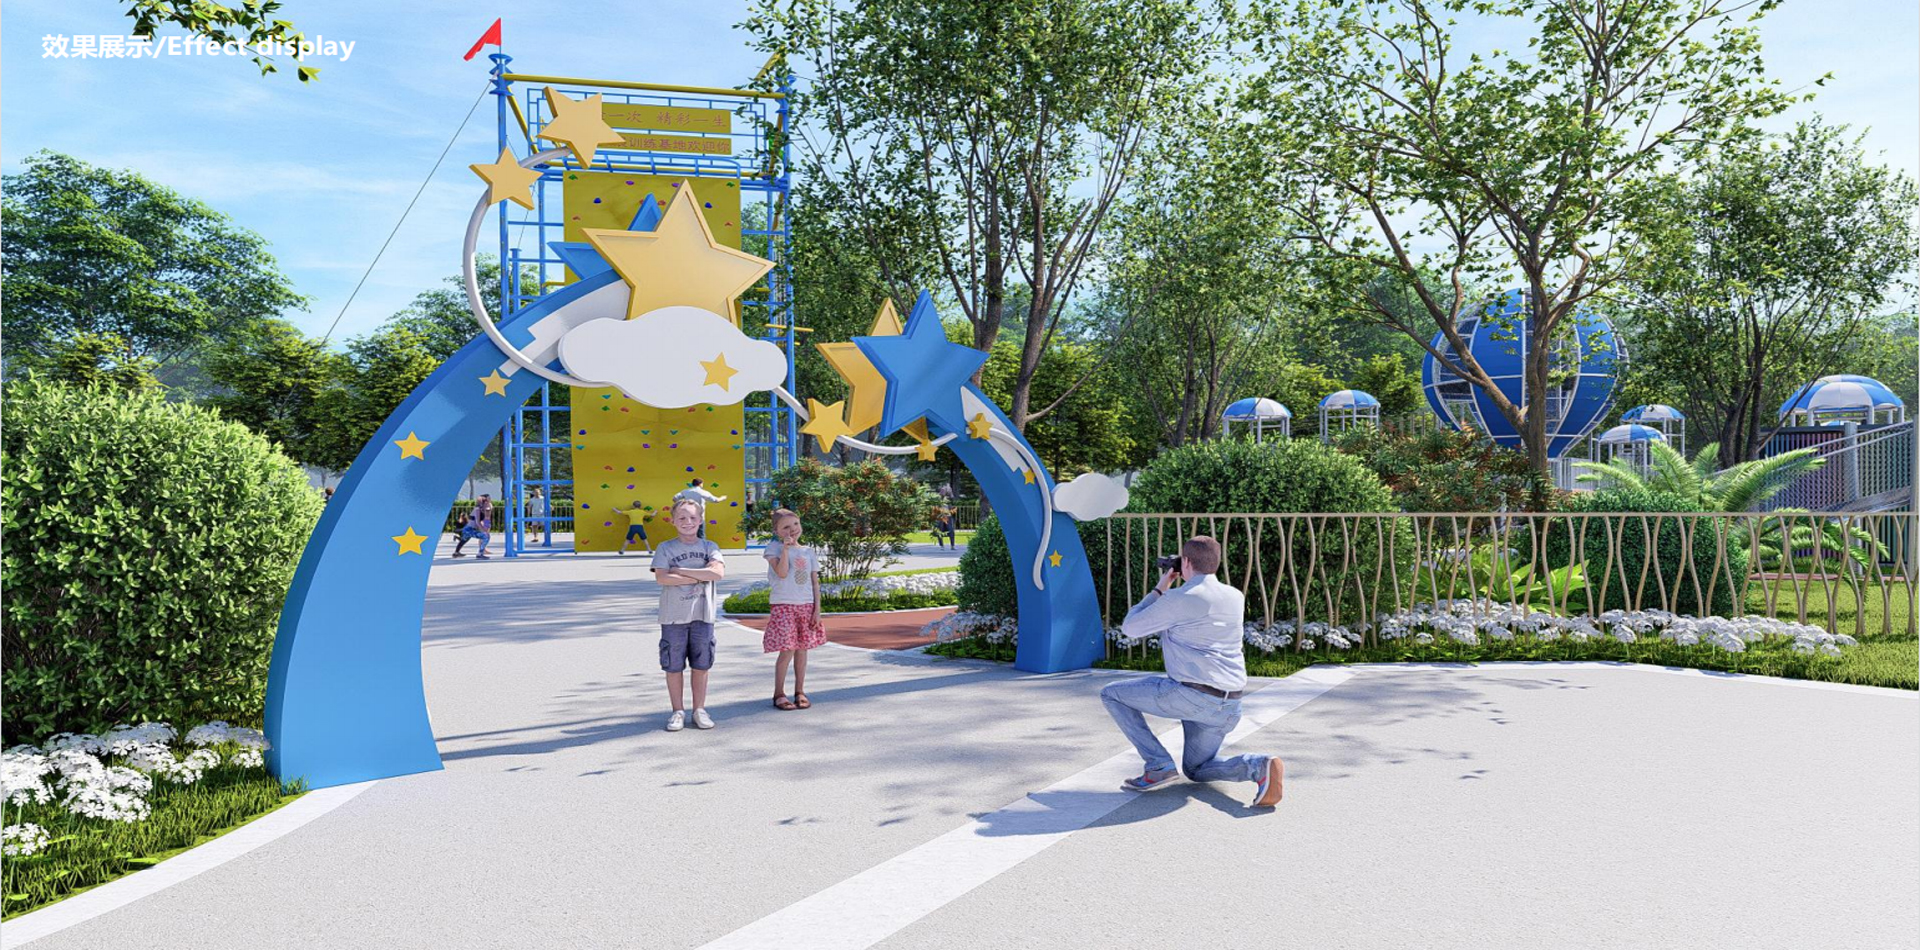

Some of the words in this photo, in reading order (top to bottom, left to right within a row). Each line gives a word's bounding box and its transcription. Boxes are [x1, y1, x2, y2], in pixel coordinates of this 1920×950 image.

[602, 110, 642, 123] 一次
[656, 111, 727, 128] 精彩一生
